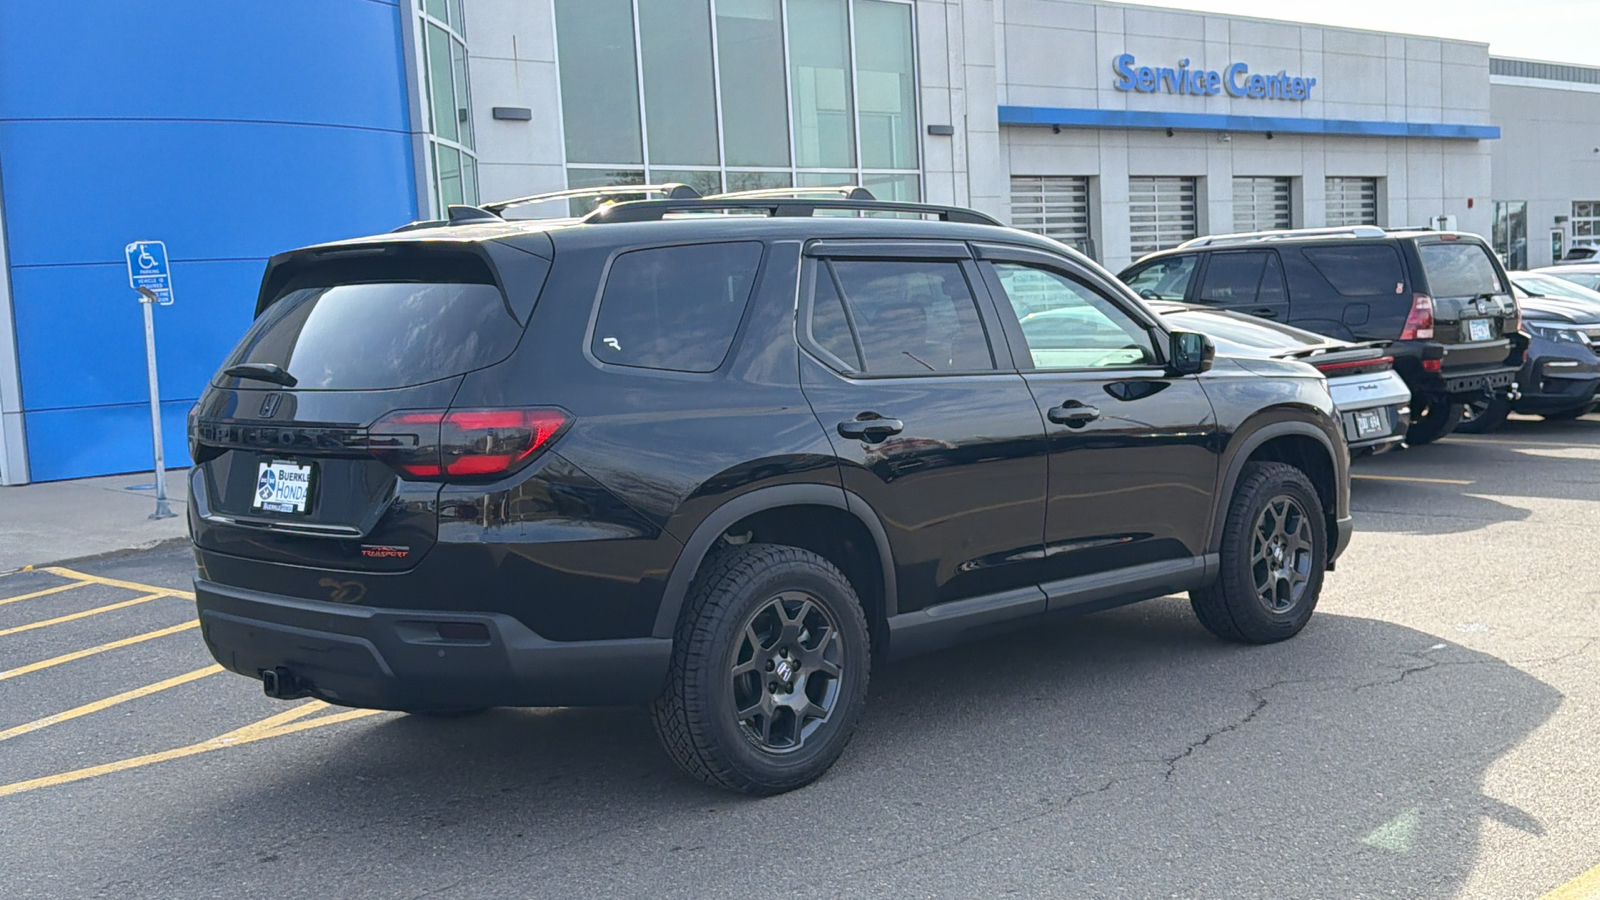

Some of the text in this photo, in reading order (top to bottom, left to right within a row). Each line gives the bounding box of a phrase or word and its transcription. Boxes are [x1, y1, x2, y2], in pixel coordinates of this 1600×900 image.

[1112, 53, 1317, 100] Service Center
[278, 470, 311, 482] BUERKLE
[275, 481, 309, 500] HONDA
